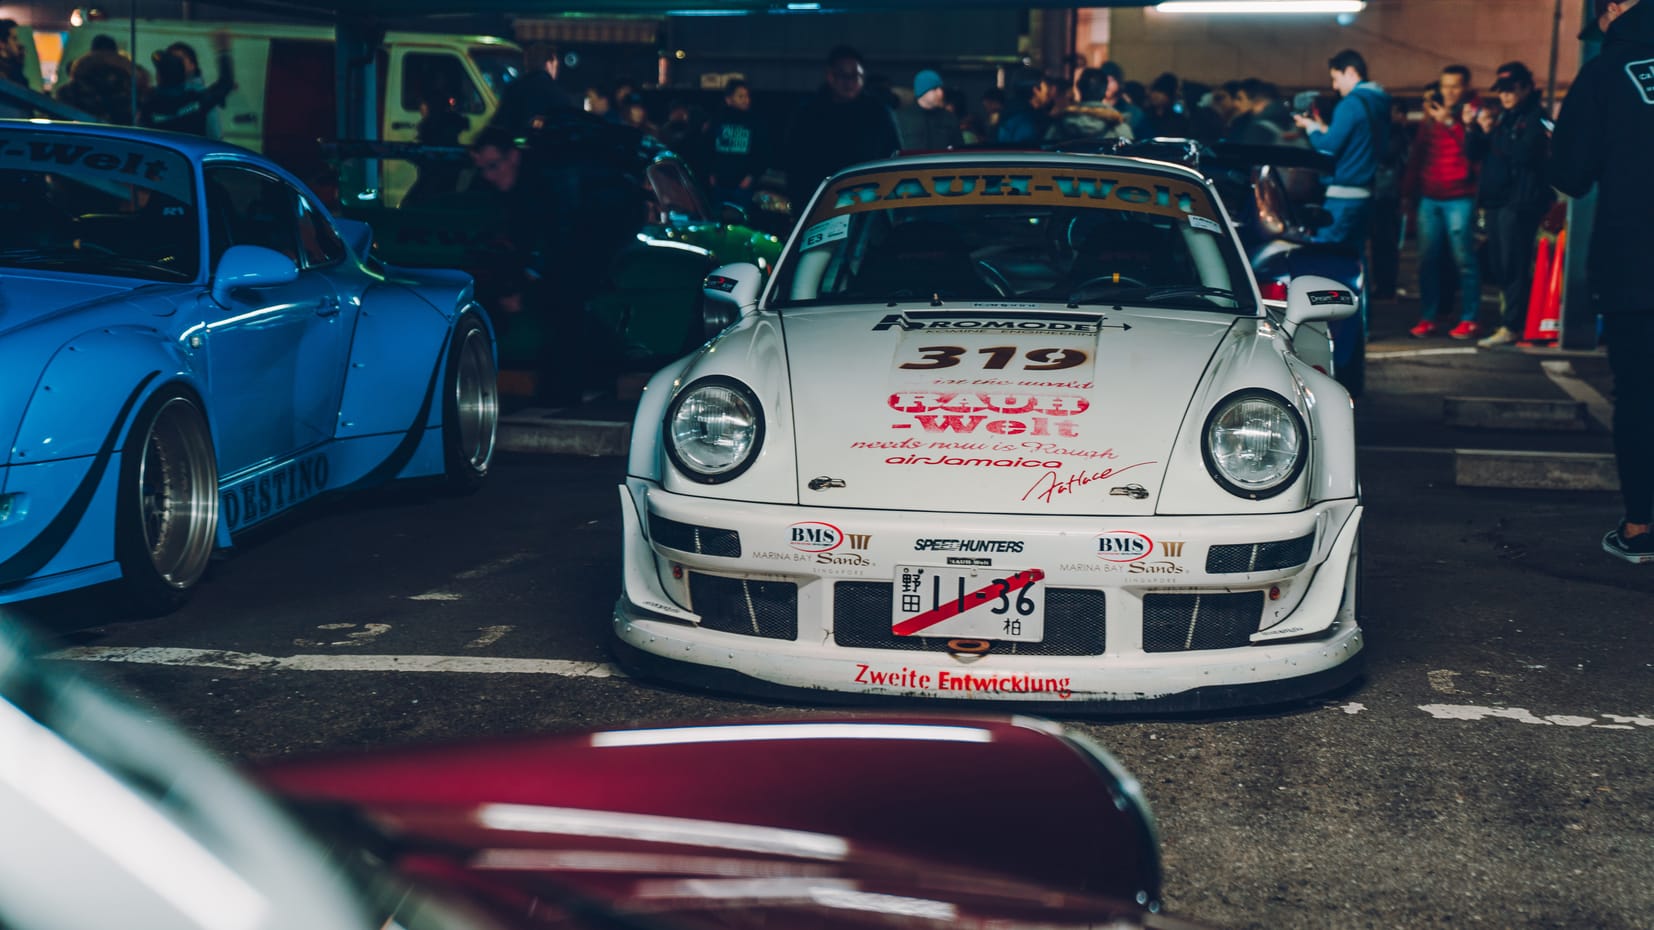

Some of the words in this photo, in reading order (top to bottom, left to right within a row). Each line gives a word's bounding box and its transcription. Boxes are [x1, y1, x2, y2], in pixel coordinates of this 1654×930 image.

[0, 139, 168, 181] -Welt
[835, 174, 1197, 213] RAUH-Welt
[898, 345, 1088, 371] 319
[887, 390, 1091, 417] RAUH
[927, 441, 989, 451] now
[991, 440, 1018, 451] is
[884, 453, 1063, 469] airJamaica
[222, 451, 330, 531] DESTINO
[791, 527, 836, 544] BMS
[914, 538, 1025, 553] SPEEDHUNTERS
[1098, 537, 1145, 553] BMS
[752, 551, 791, 561] MARINA
[793, 552, 812, 562] BAY
[815, 551, 871, 567] Sands
[1059, 562, 1101, 572] MARINA
[1103, 563, 1124, 573] BAY
[1127, 560, 1184, 574] Sands
[932, 574, 1037, 617] 11-36
[854, 663, 931, 690] Zweite
[937, 670, 1072, 699] Entwicklung
